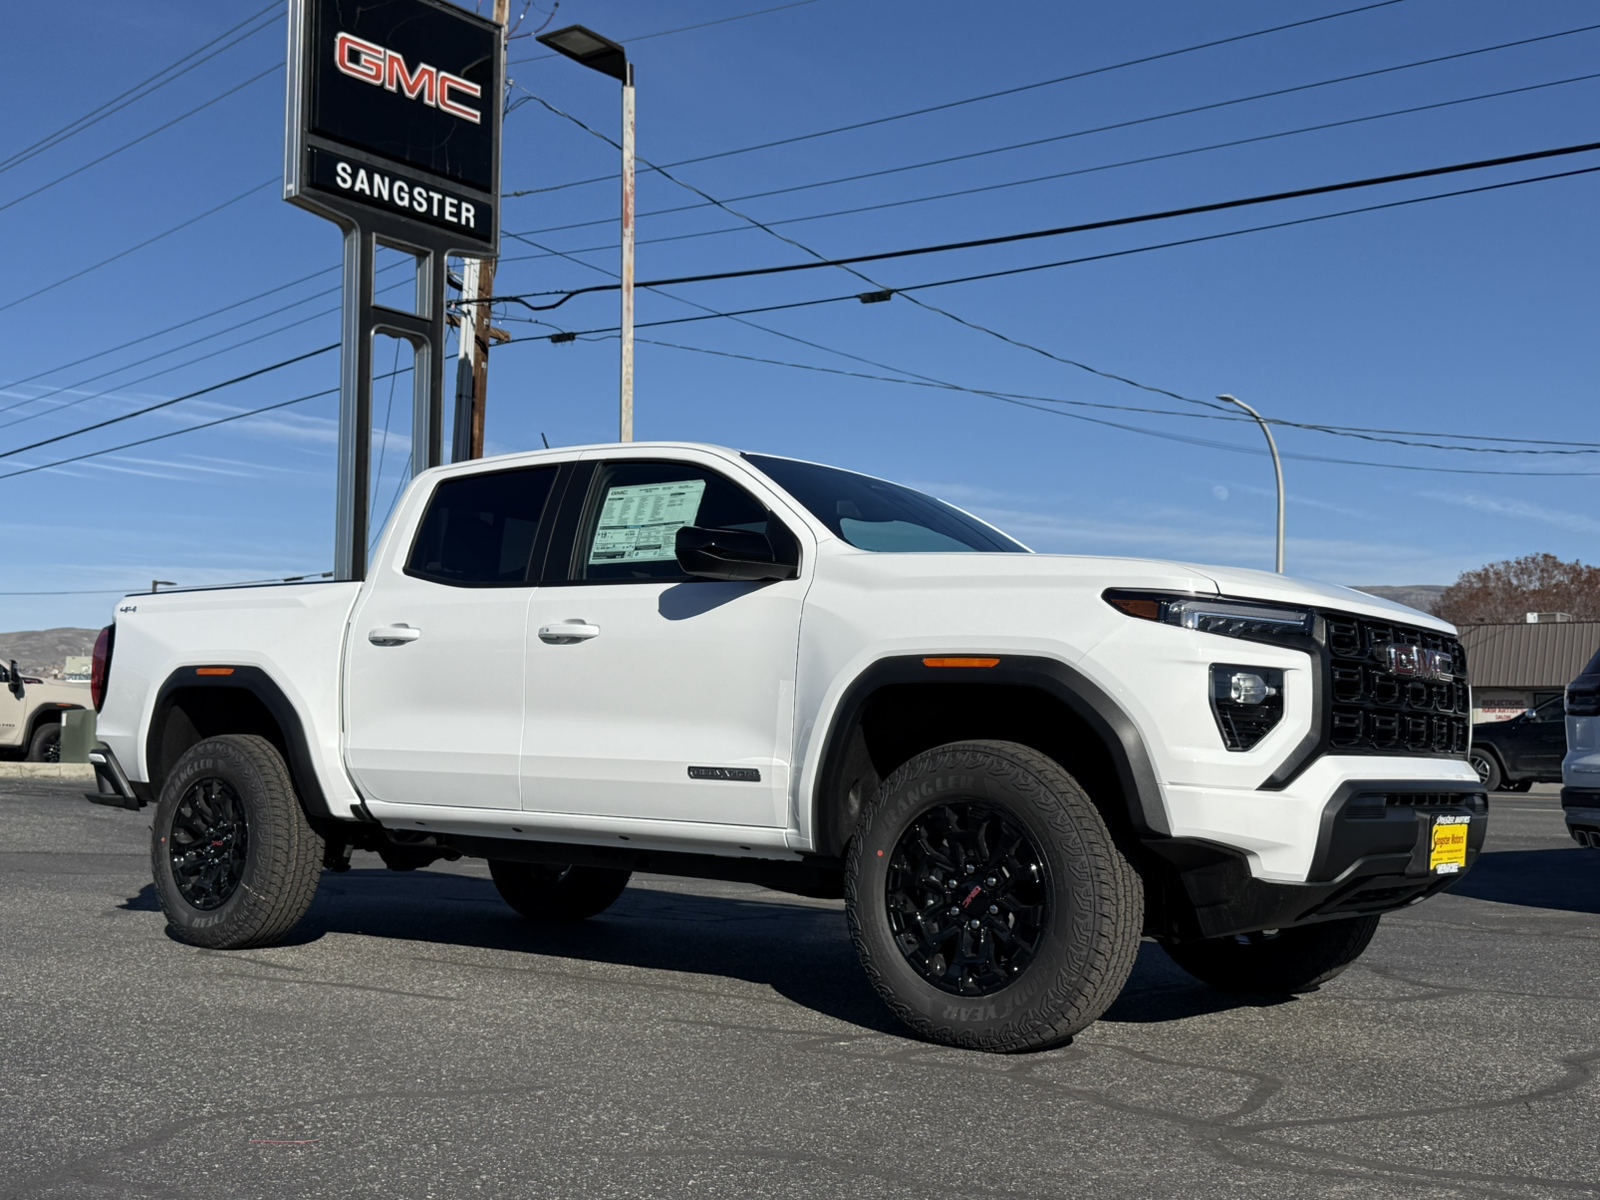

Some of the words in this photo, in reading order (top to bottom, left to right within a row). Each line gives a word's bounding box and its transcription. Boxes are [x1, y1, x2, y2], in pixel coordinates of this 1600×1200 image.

[334, 31, 481, 125] GMC
[335, 161, 475, 229] SANGSTER
[1387, 643, 1454, 682] GMC
[961, 885, 982, 909] GMC
